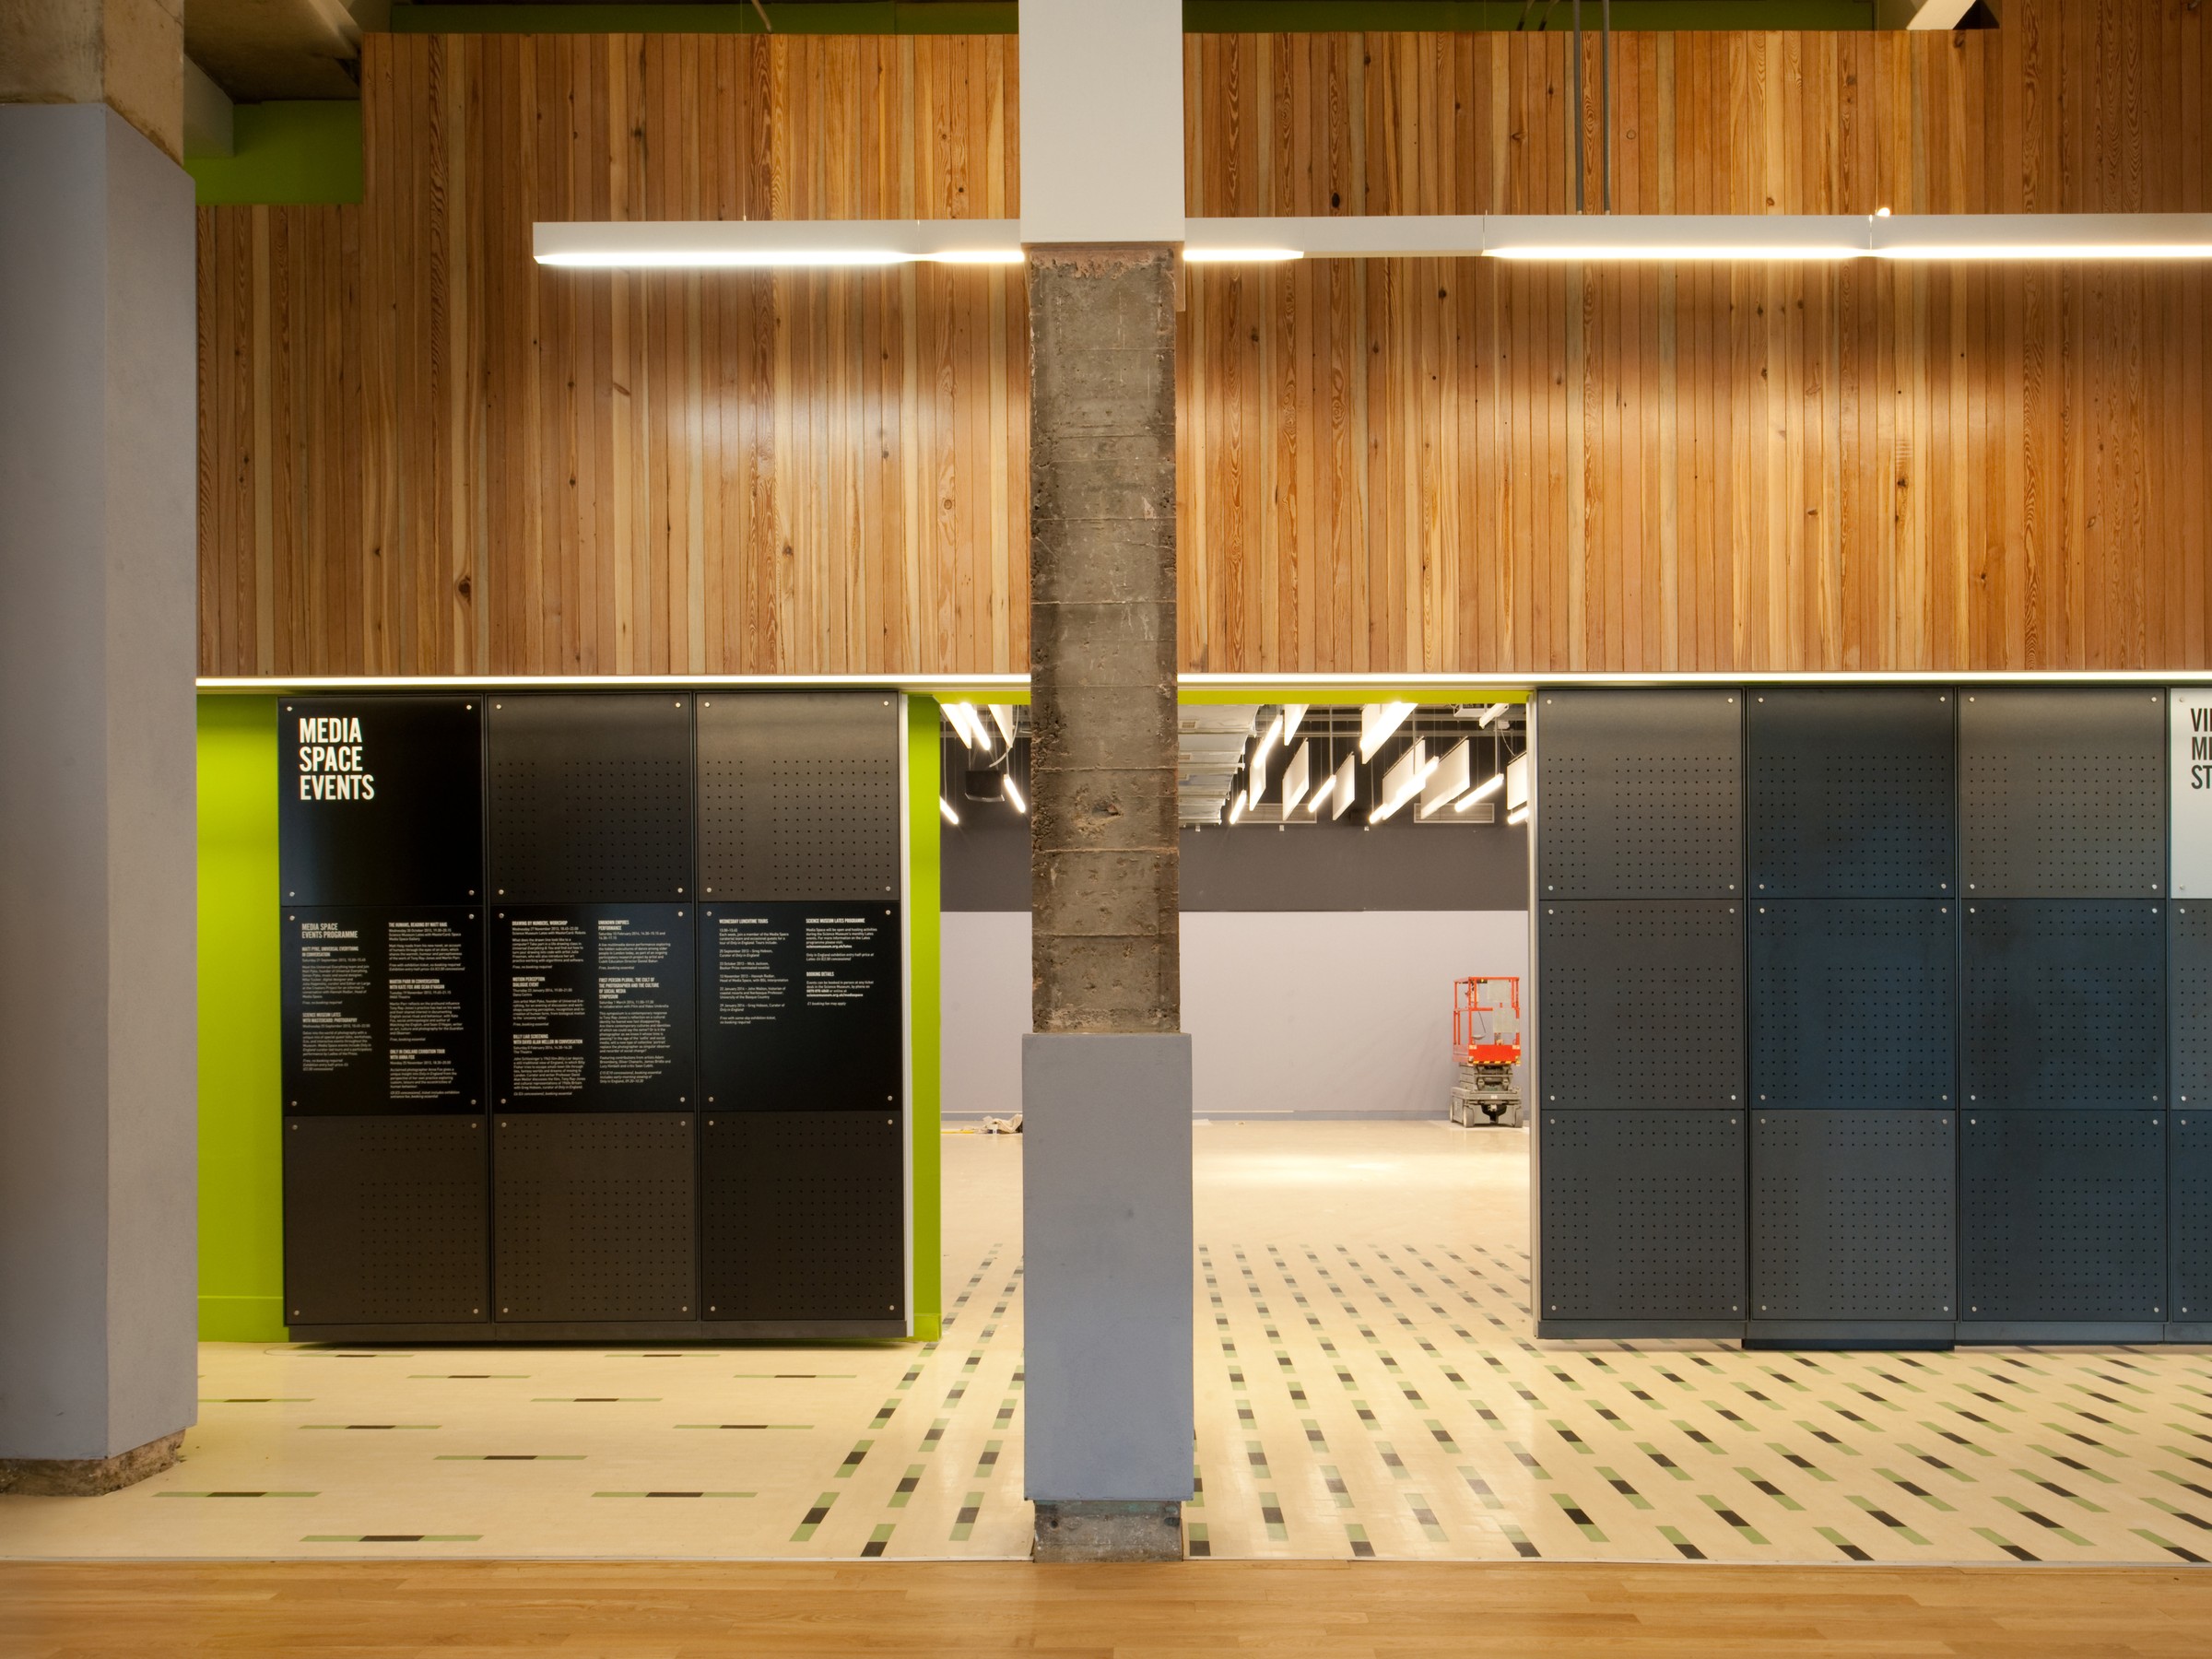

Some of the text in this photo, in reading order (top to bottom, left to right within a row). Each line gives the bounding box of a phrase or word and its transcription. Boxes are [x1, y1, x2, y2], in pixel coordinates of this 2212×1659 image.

[300, 718, 362, 743] MEDIA
[300, 746, 363, 771] SPACE
[300, 774, 374, 800] EVENTS
